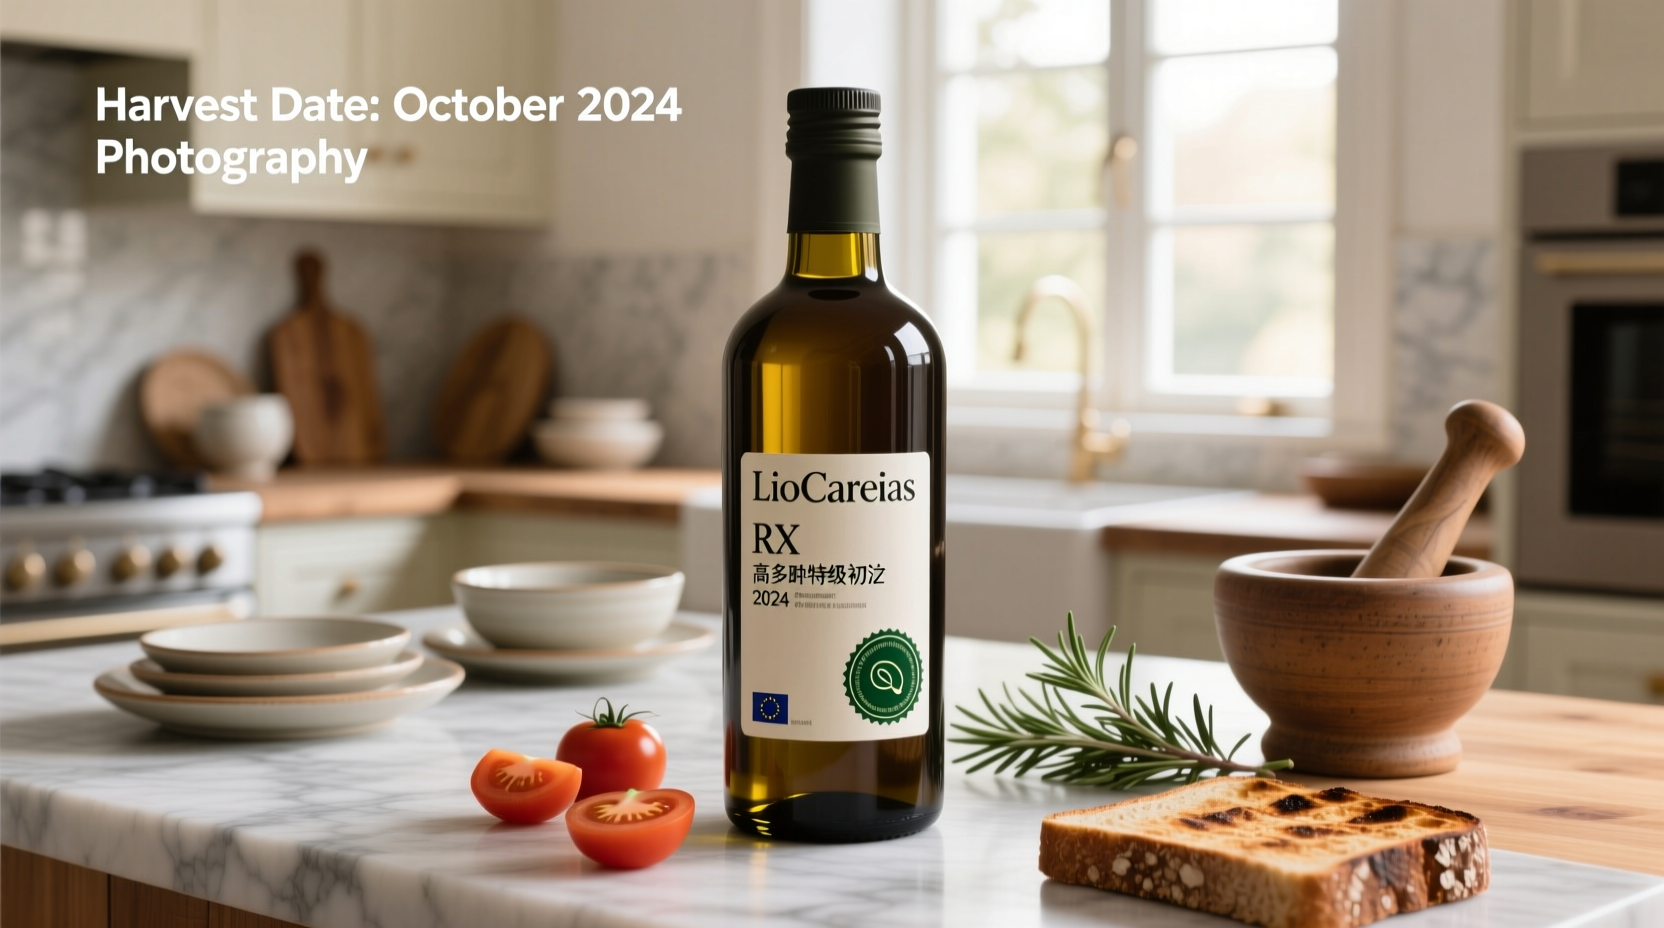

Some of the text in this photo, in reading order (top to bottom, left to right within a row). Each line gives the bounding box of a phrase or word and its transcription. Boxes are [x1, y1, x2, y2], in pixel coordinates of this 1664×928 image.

[752, 470, 916, 504] LioCareias
[752, 522, 801, 556] RX
[752, 589, 790, 608] 2024
